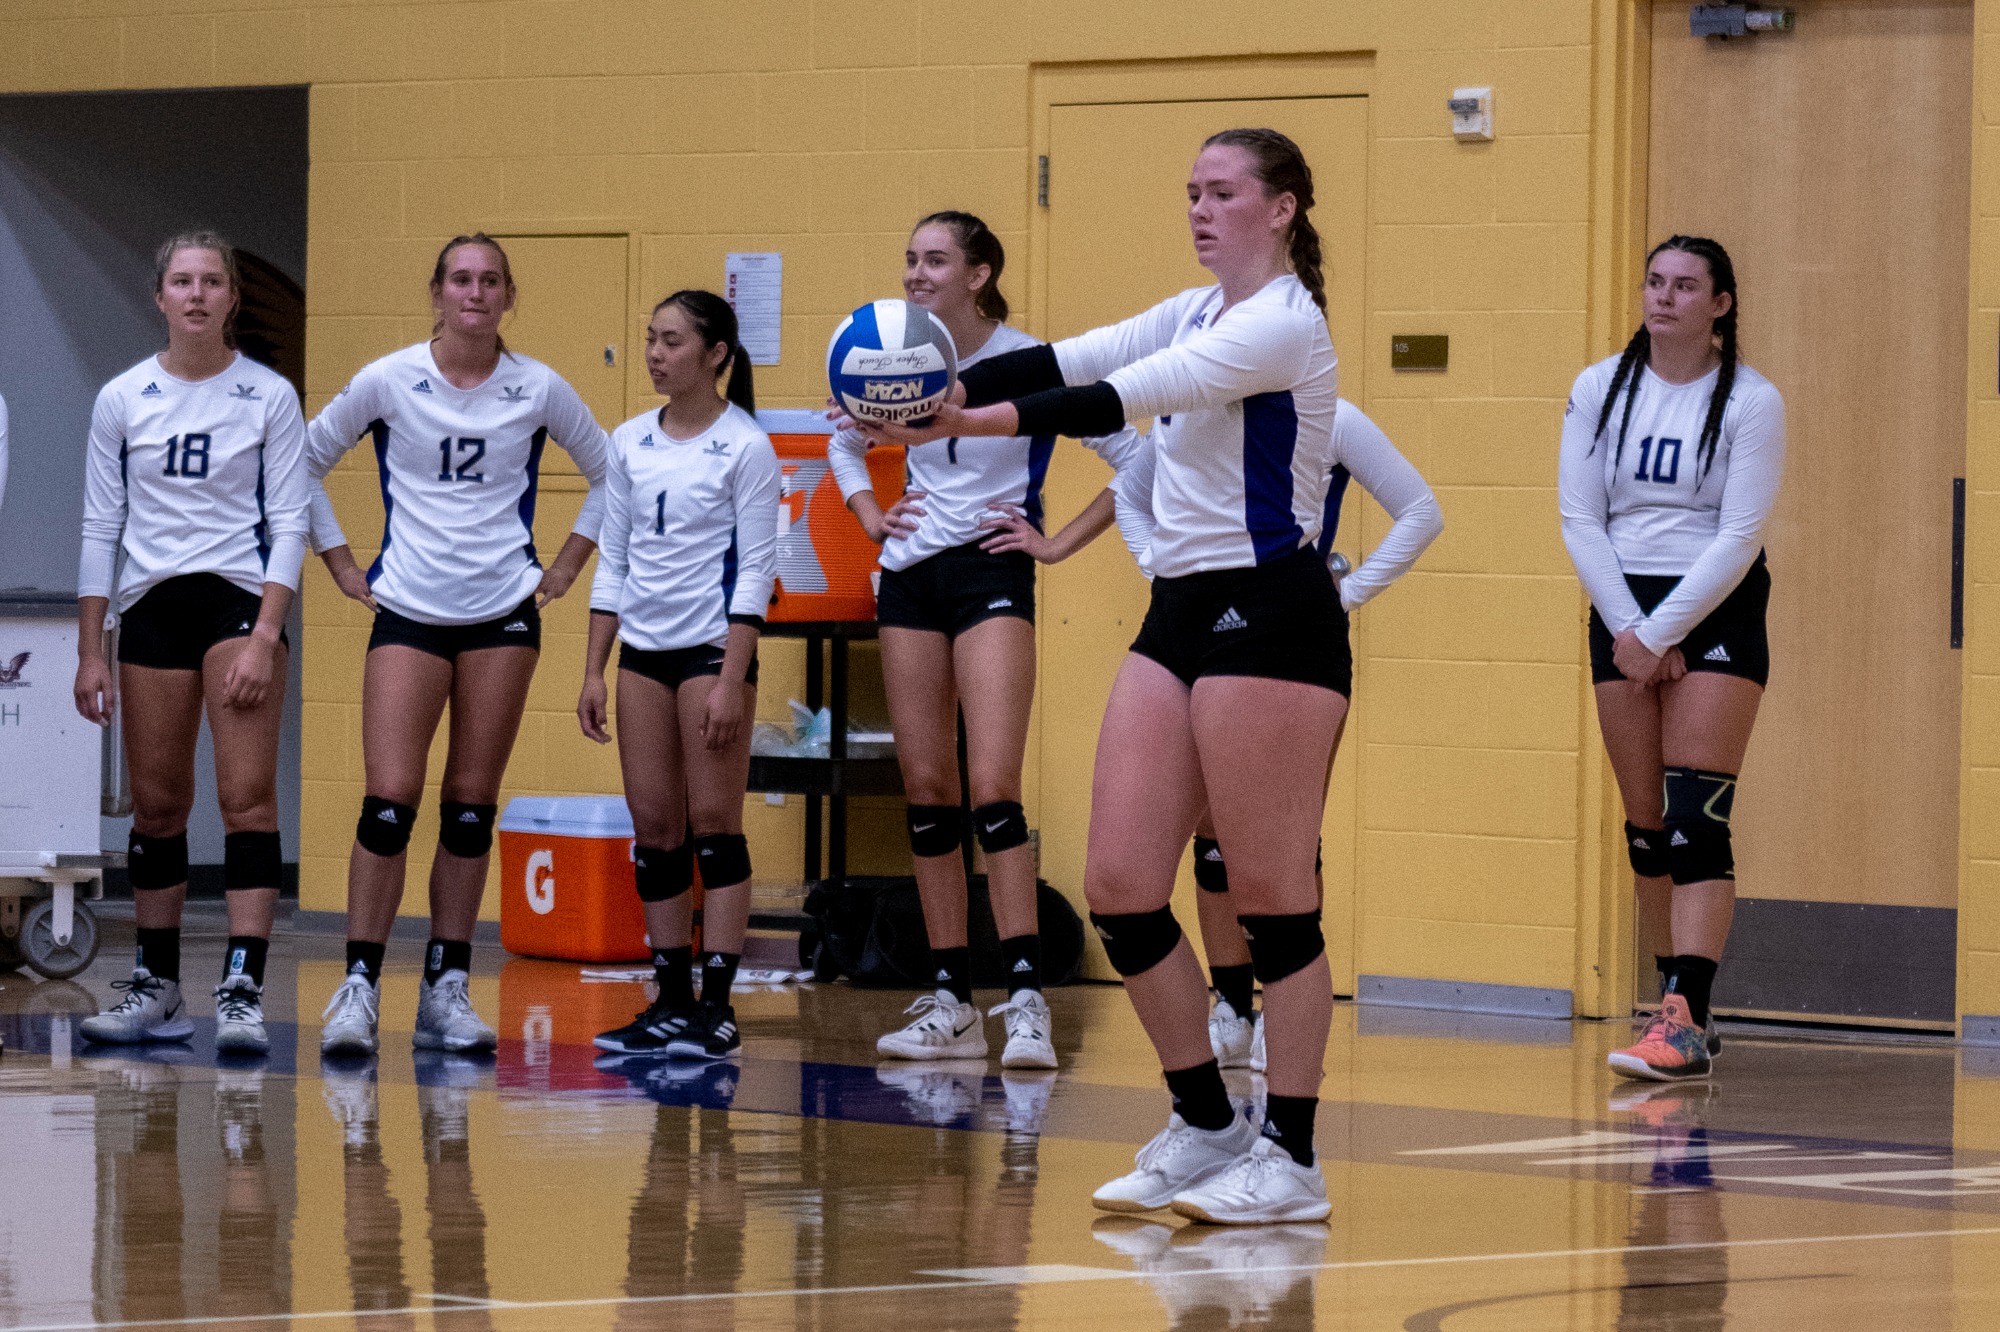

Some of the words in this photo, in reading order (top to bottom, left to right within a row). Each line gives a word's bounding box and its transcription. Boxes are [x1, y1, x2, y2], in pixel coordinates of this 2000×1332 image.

[858, 355, 892, 371] Touch
[896, 351, 929, 369] Super
[858, 401, 932, 421] molten
[864, 378, 924, 401] NCAA
[162, 432, 212, 480] 18
[437, 435, 487, 484] 12
[1634, 435, 1683, 485] 10
[655, 490, 668, 536] 1
[525, 848, 555, 915] G
